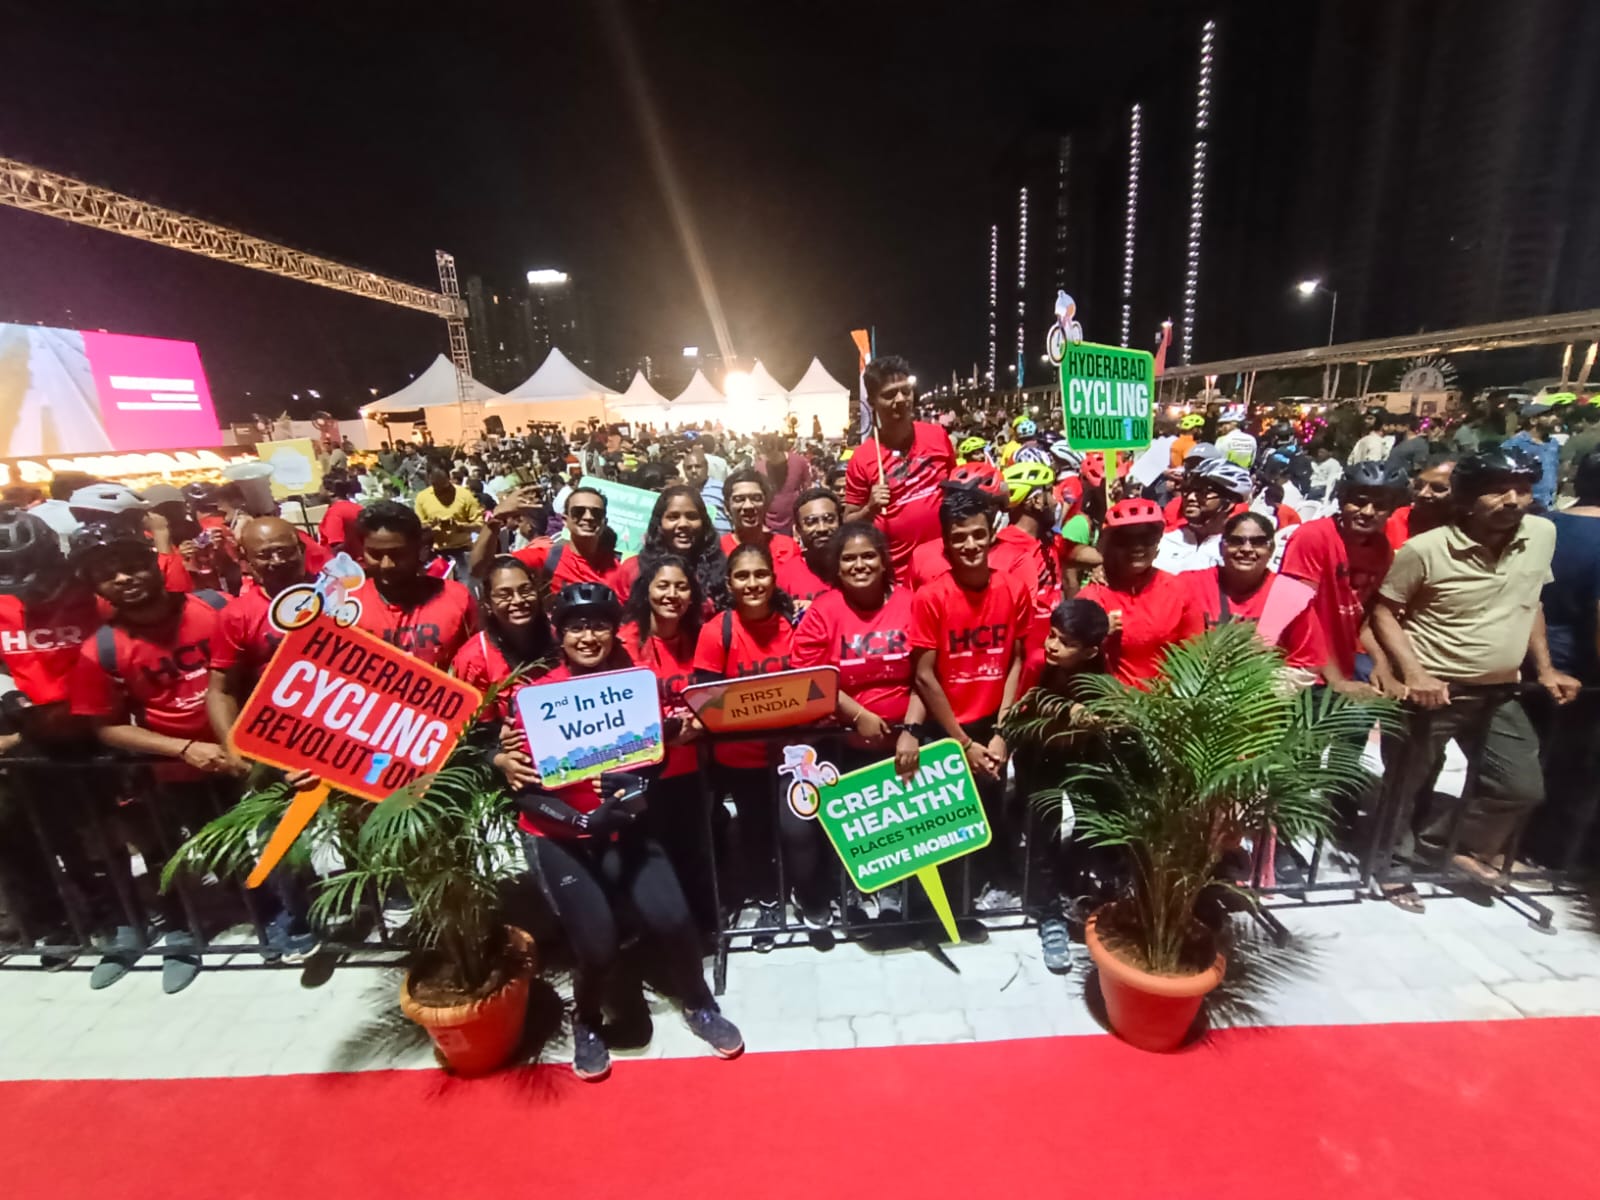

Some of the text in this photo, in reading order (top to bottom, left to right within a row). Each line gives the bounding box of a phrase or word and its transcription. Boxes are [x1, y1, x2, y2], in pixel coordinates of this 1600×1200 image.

[1069, 352, 1146, 381] HYDERABAD
[1069, 378, 1148, 417] CYCLING
[1, 626, 81, 651] HCR
[301, 627, 464, 720] HYDERABAD
[540, 686, 633, 721] 2nd In the
[731, 698, 800, 719] IN INDIA
[740, 687, 783, 704] FIRST
[271, 660, 448, 766] CYCLING
[559, 709, 625, 741] World
[841, 779, 966, 841] HEALTHY
[851, 804, 978, 858] PLACES THROUGH
[857, 847, 912, 879] ACTIVE
